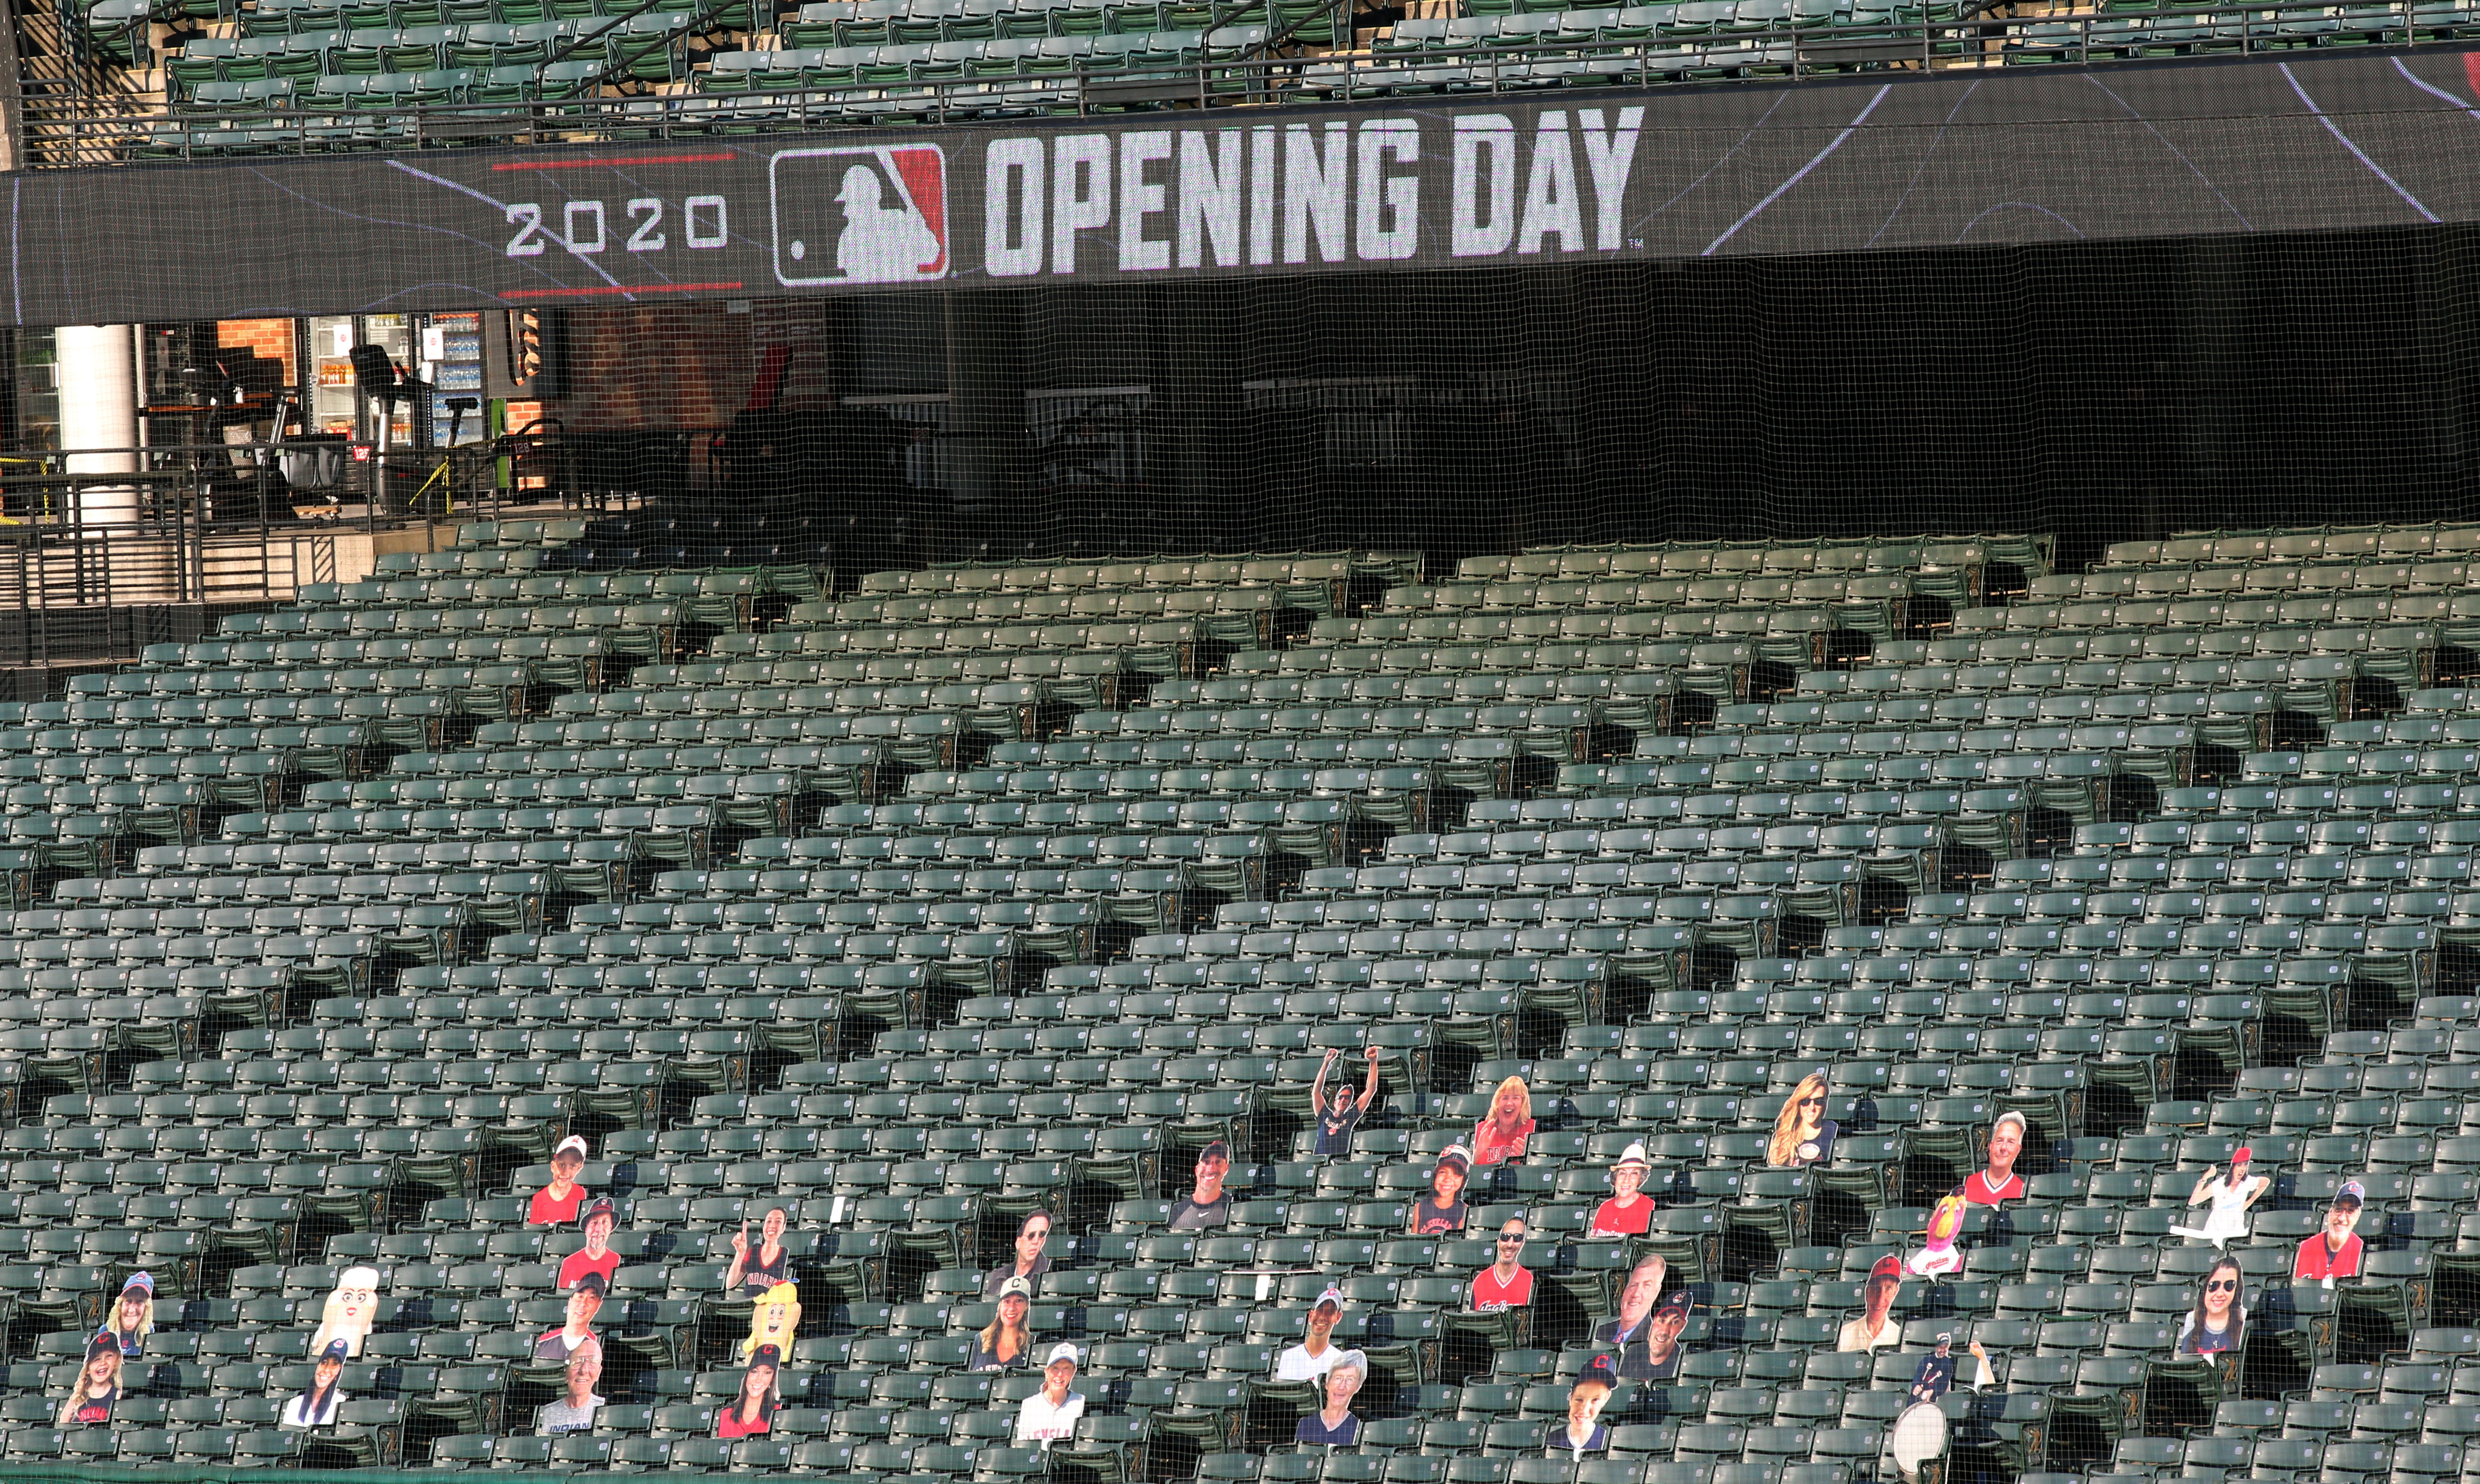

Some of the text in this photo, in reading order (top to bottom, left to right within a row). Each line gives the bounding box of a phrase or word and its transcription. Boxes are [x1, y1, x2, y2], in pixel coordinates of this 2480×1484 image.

[985, 118, 1419, 277] OPENING
[1451, 106, 1645, 258] DAY
[505, 195, 727, 257] 2020
[514, 443, 531, 454] 128
[1011, 1278, 1020, 1288] C
[97, 1331, 110, 1344] C
[762, 1344, 774, 1354] C
[1060, 1345, 1068, 1354] C
[1593, 1354, 1609, 1368] C
